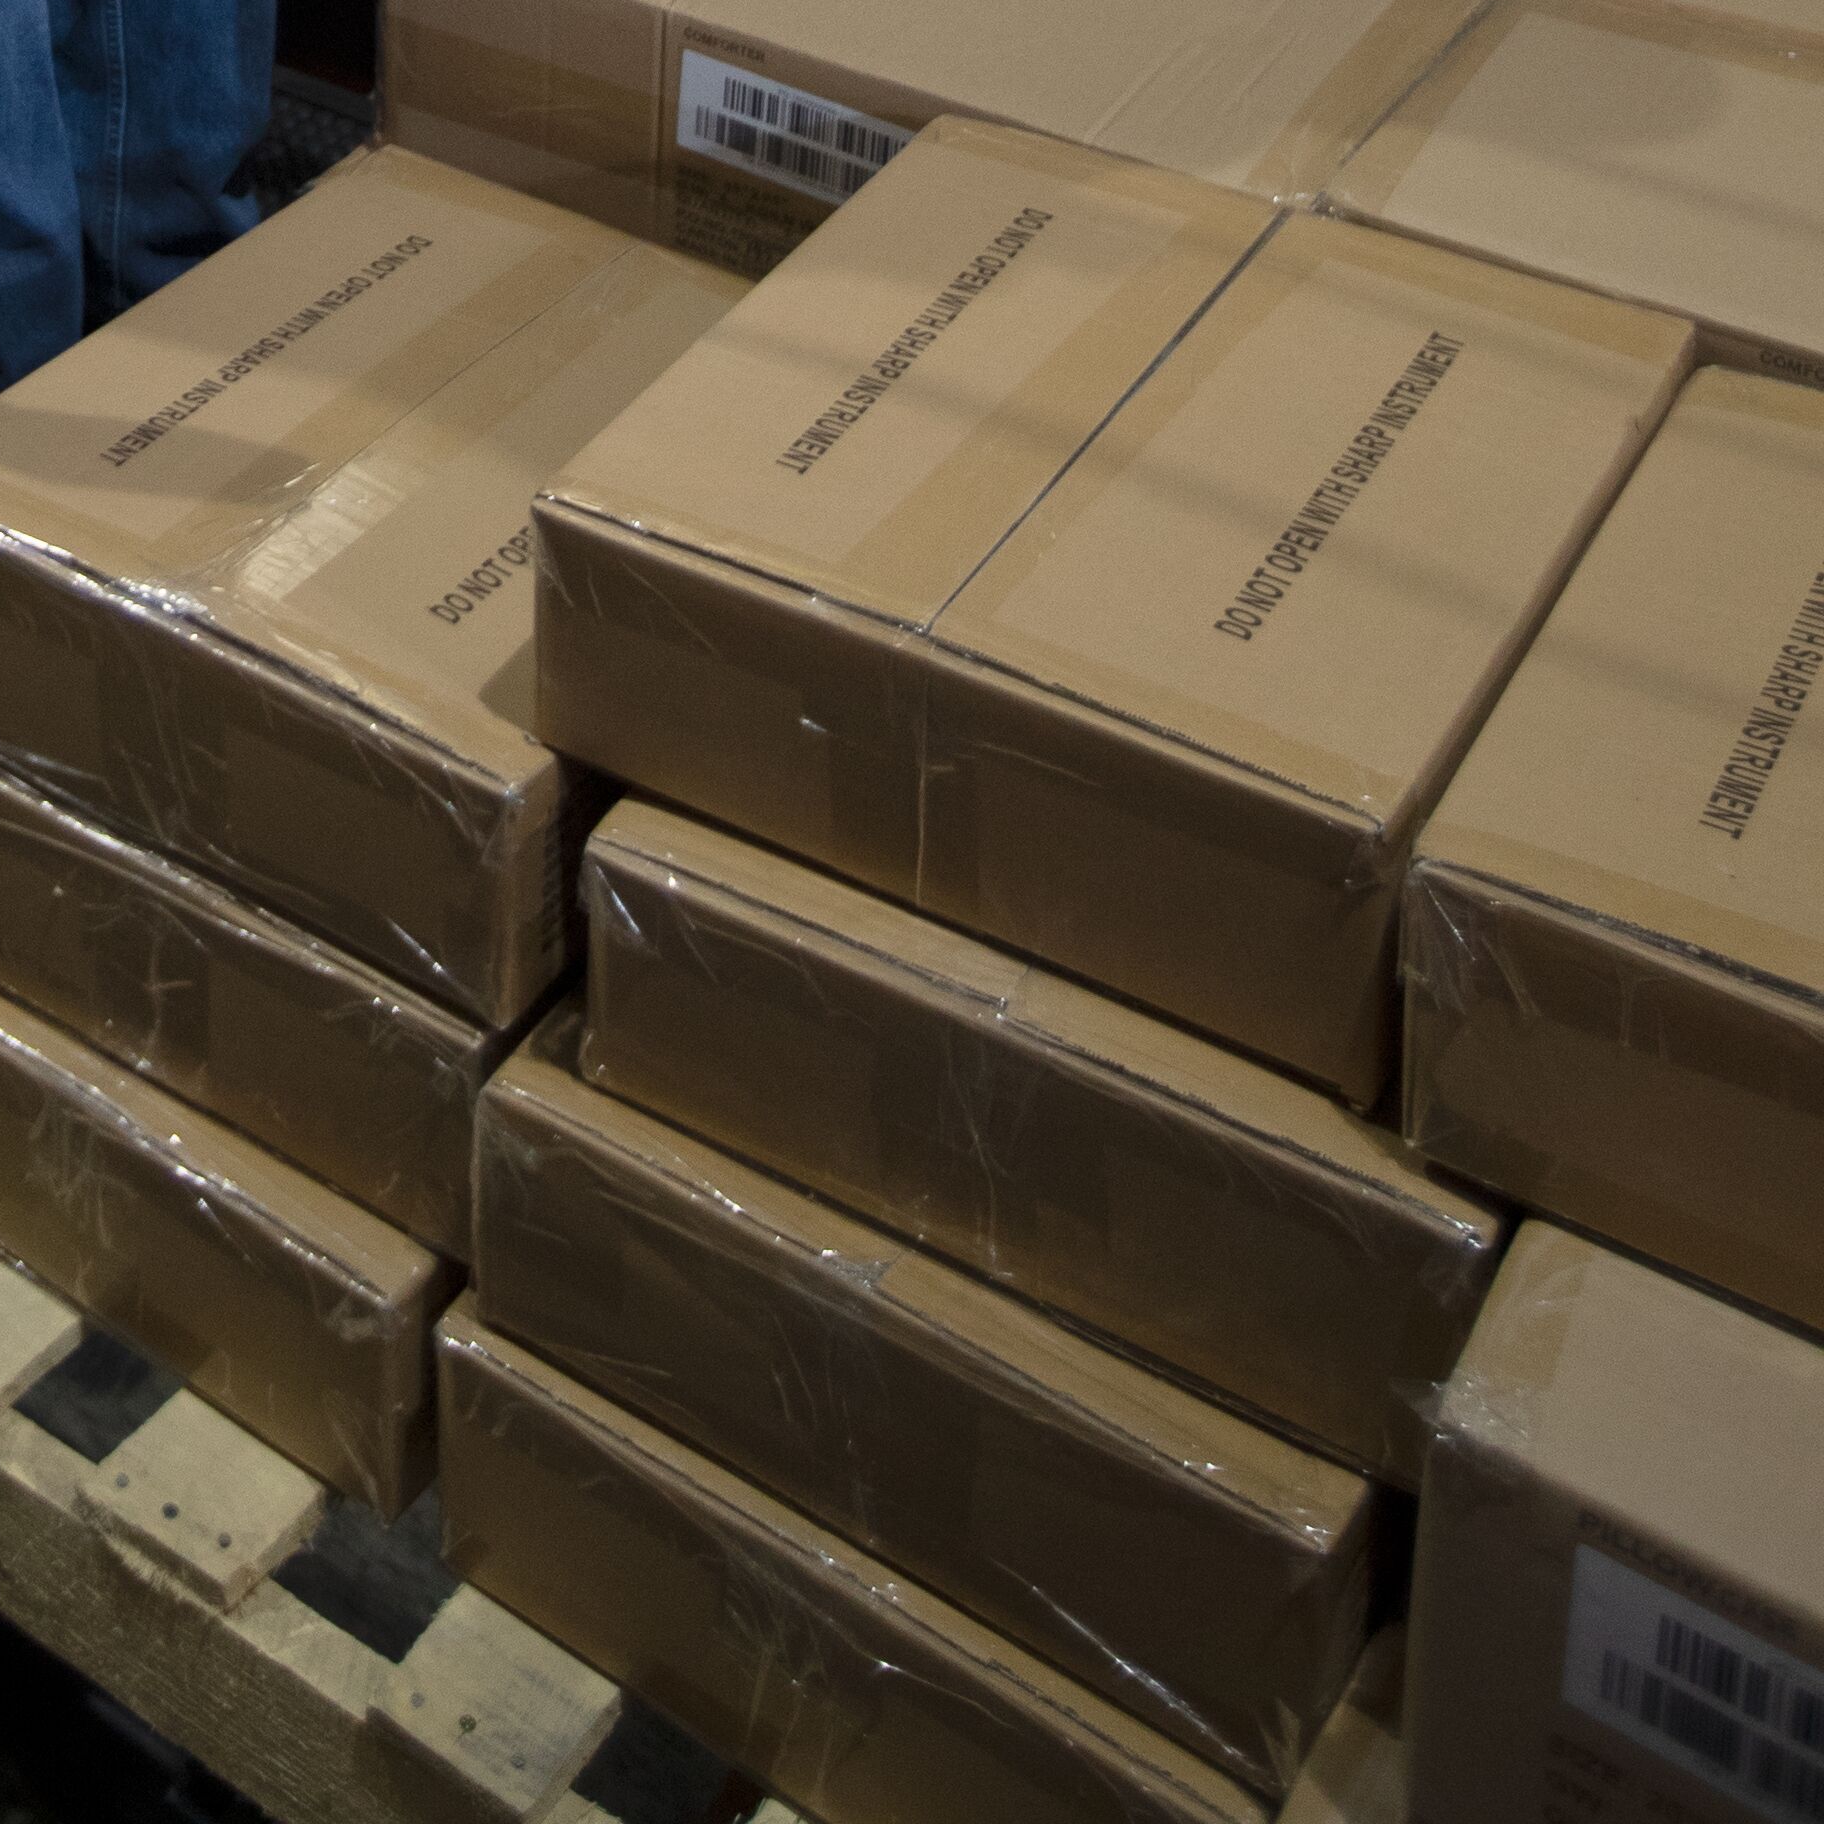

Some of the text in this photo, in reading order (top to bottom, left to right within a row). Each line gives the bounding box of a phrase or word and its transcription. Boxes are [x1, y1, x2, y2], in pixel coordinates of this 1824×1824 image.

[683, 25, 766, 63] COMFORTER
[99, 234, 434, 468] DO NOT OPEN WITH SHARP INSTRUMENT
[775, 207, 1054, 475] DO NOT OPEN WITH SHARP INSTRUMENT
[1213, 330, 1465, 642] DO NOT OPEN WITH SHARP INSTRUMENT
[429, 525, 530, 625] DO NOT OP
[1759, 643, 1824, 713] SHARP
[1698, 706, 1796, 841] INSTRUMENT
